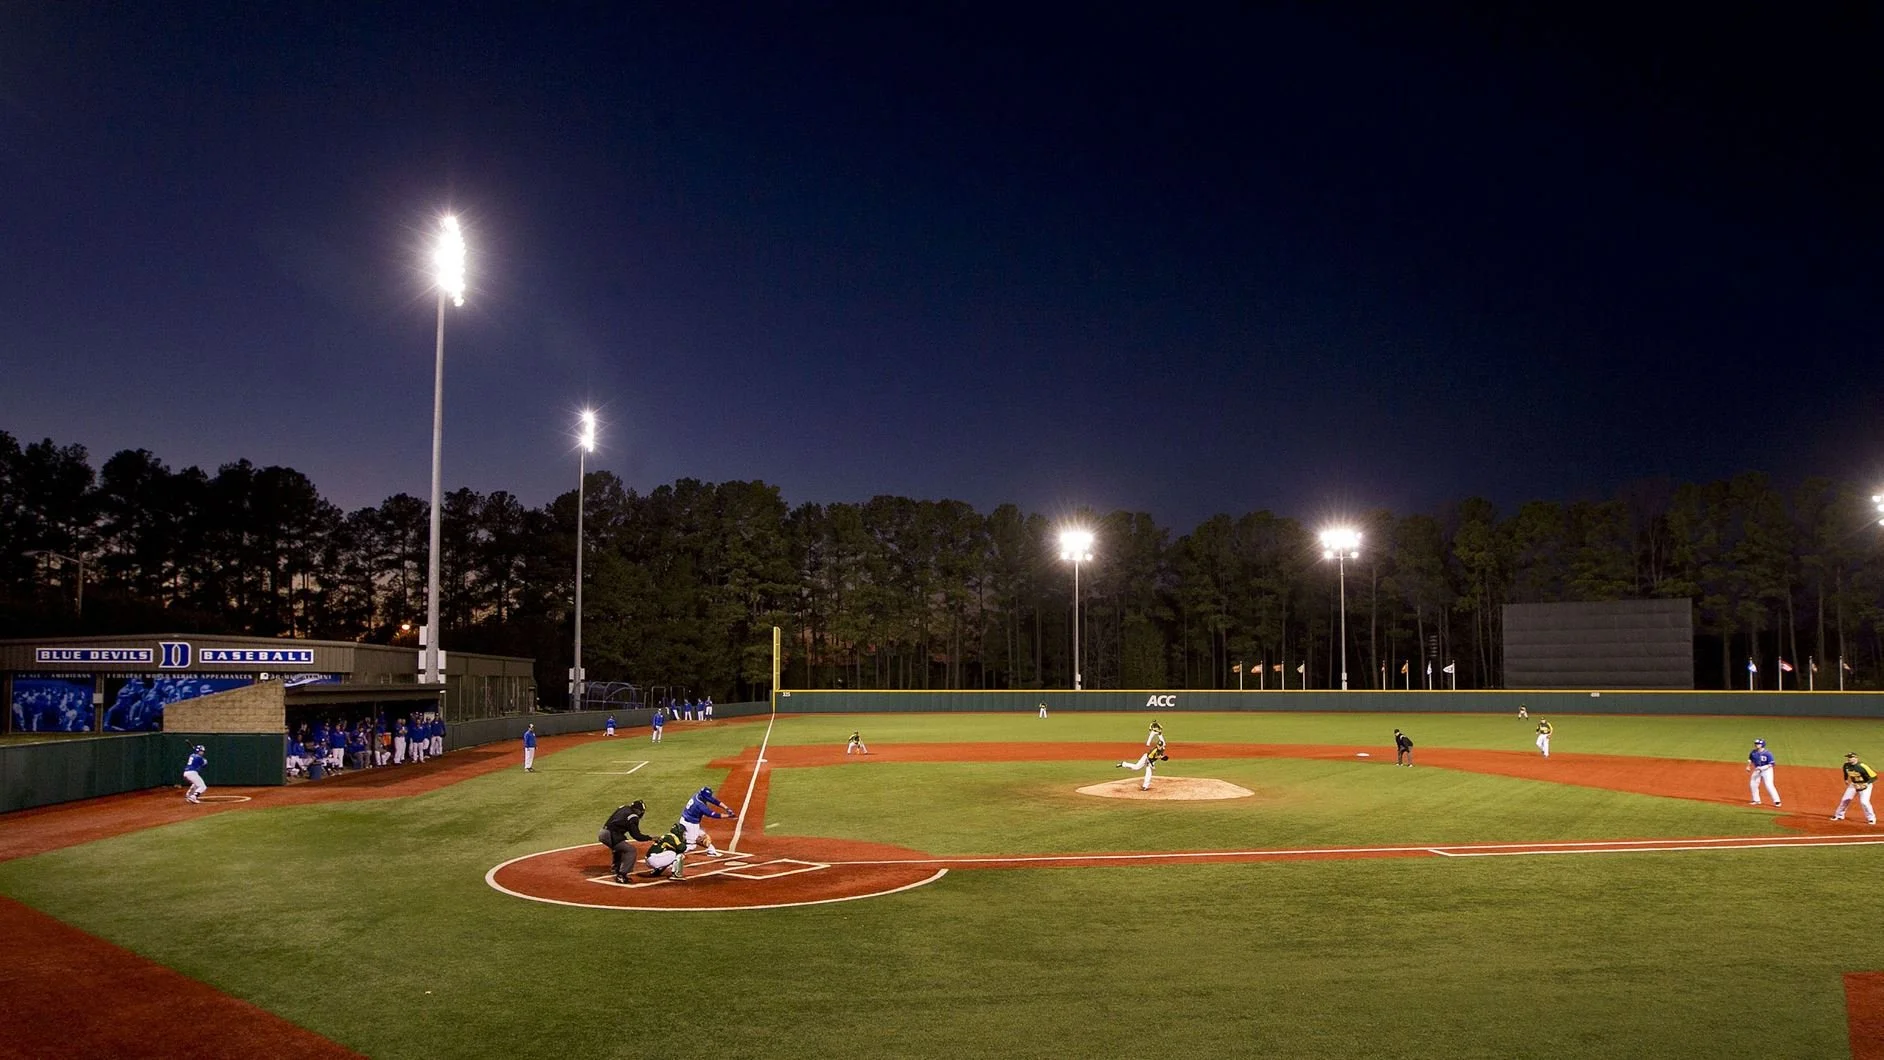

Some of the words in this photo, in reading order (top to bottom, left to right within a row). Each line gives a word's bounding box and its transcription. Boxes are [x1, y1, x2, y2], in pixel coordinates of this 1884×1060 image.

[40, 651, 82, 660] BLUE
[90, 651, 148, 660] DEVILS
[158, 641, 192, 668] D
[203, 651, 309, 661] BASEBALL
[1146, 694, 1177, 707] ACC
